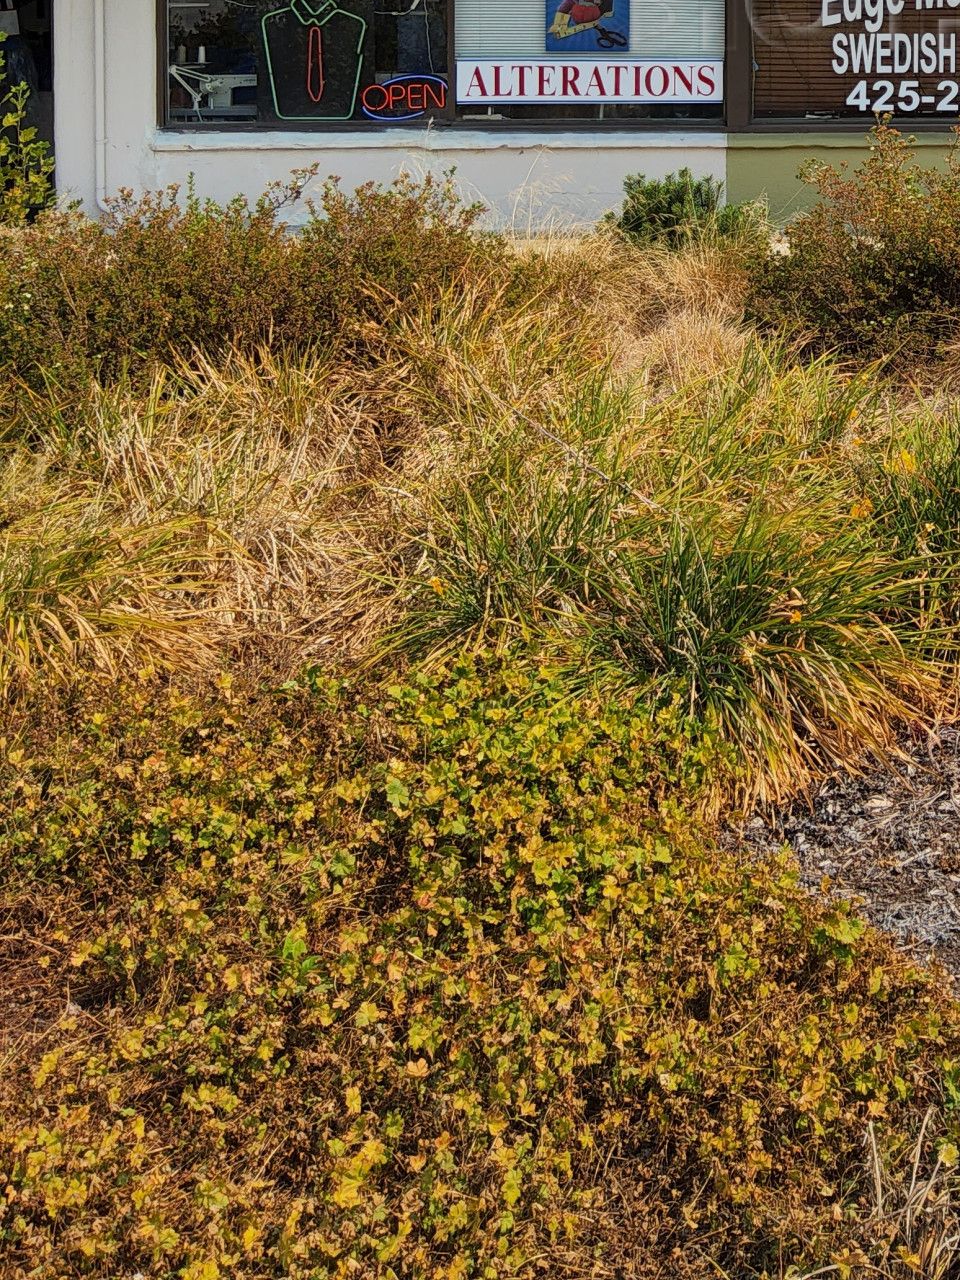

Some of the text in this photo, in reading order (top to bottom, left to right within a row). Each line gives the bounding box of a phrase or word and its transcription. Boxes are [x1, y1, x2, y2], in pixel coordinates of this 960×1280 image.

[831, 32, 956, 75] SWEDISH
[362, 83, 446, 111] OPEN
[466, 64, 716, 99] ALTERATIONS
